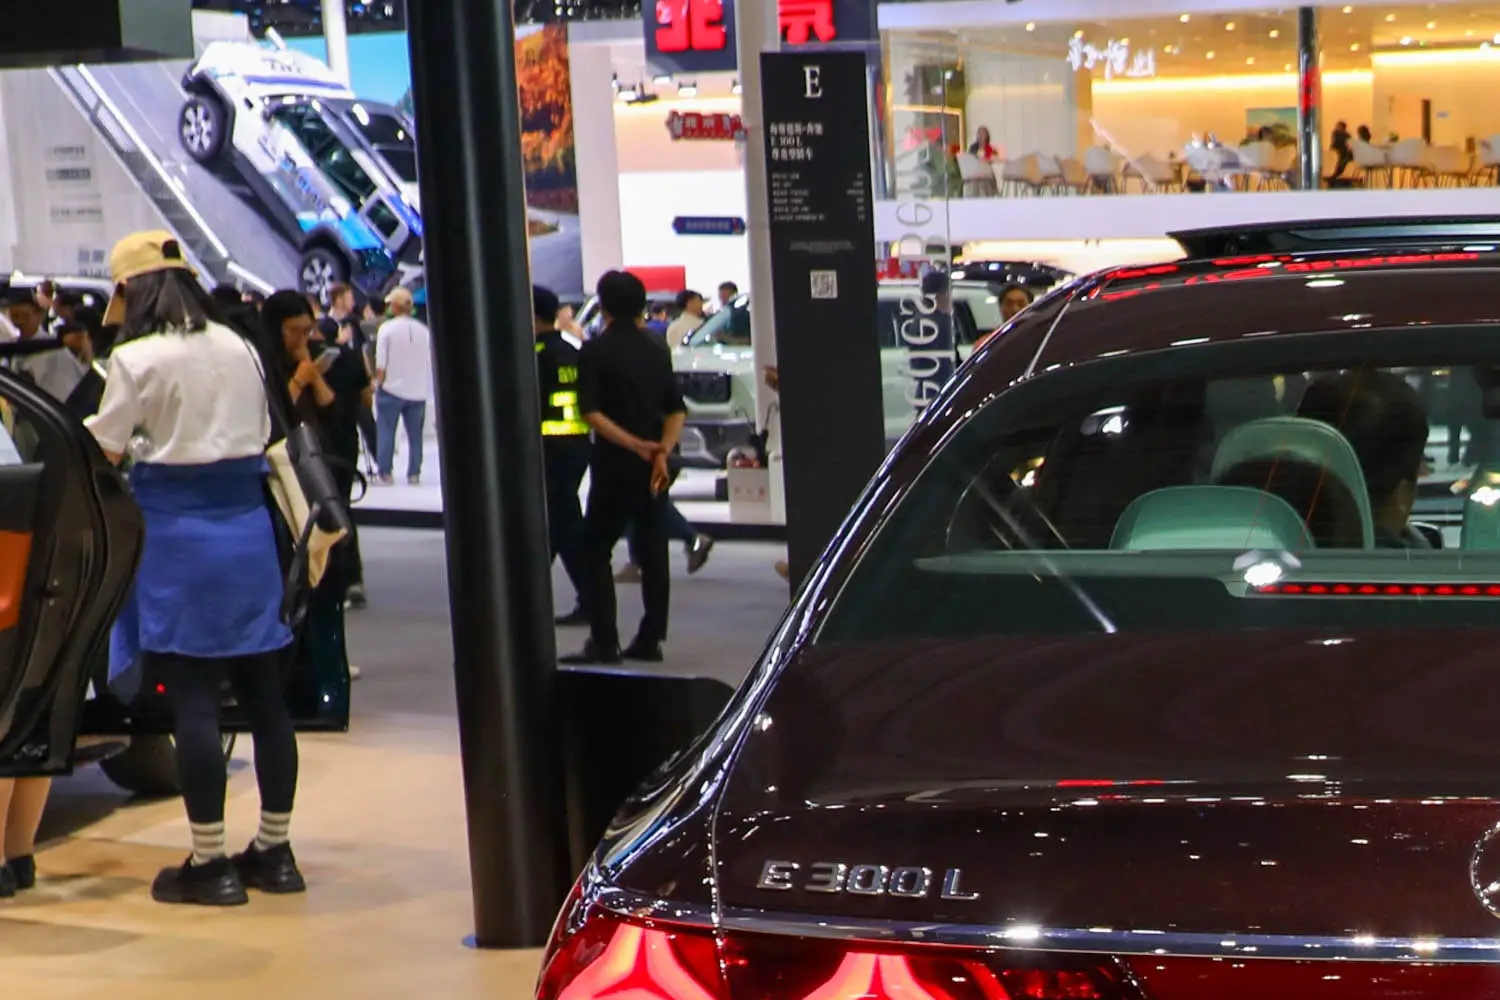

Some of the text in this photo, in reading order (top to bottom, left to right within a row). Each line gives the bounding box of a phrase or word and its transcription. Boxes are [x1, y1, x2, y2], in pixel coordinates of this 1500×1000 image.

[803, 65, 822, 98] E
[756, 860, 980, 900] E 300 L
